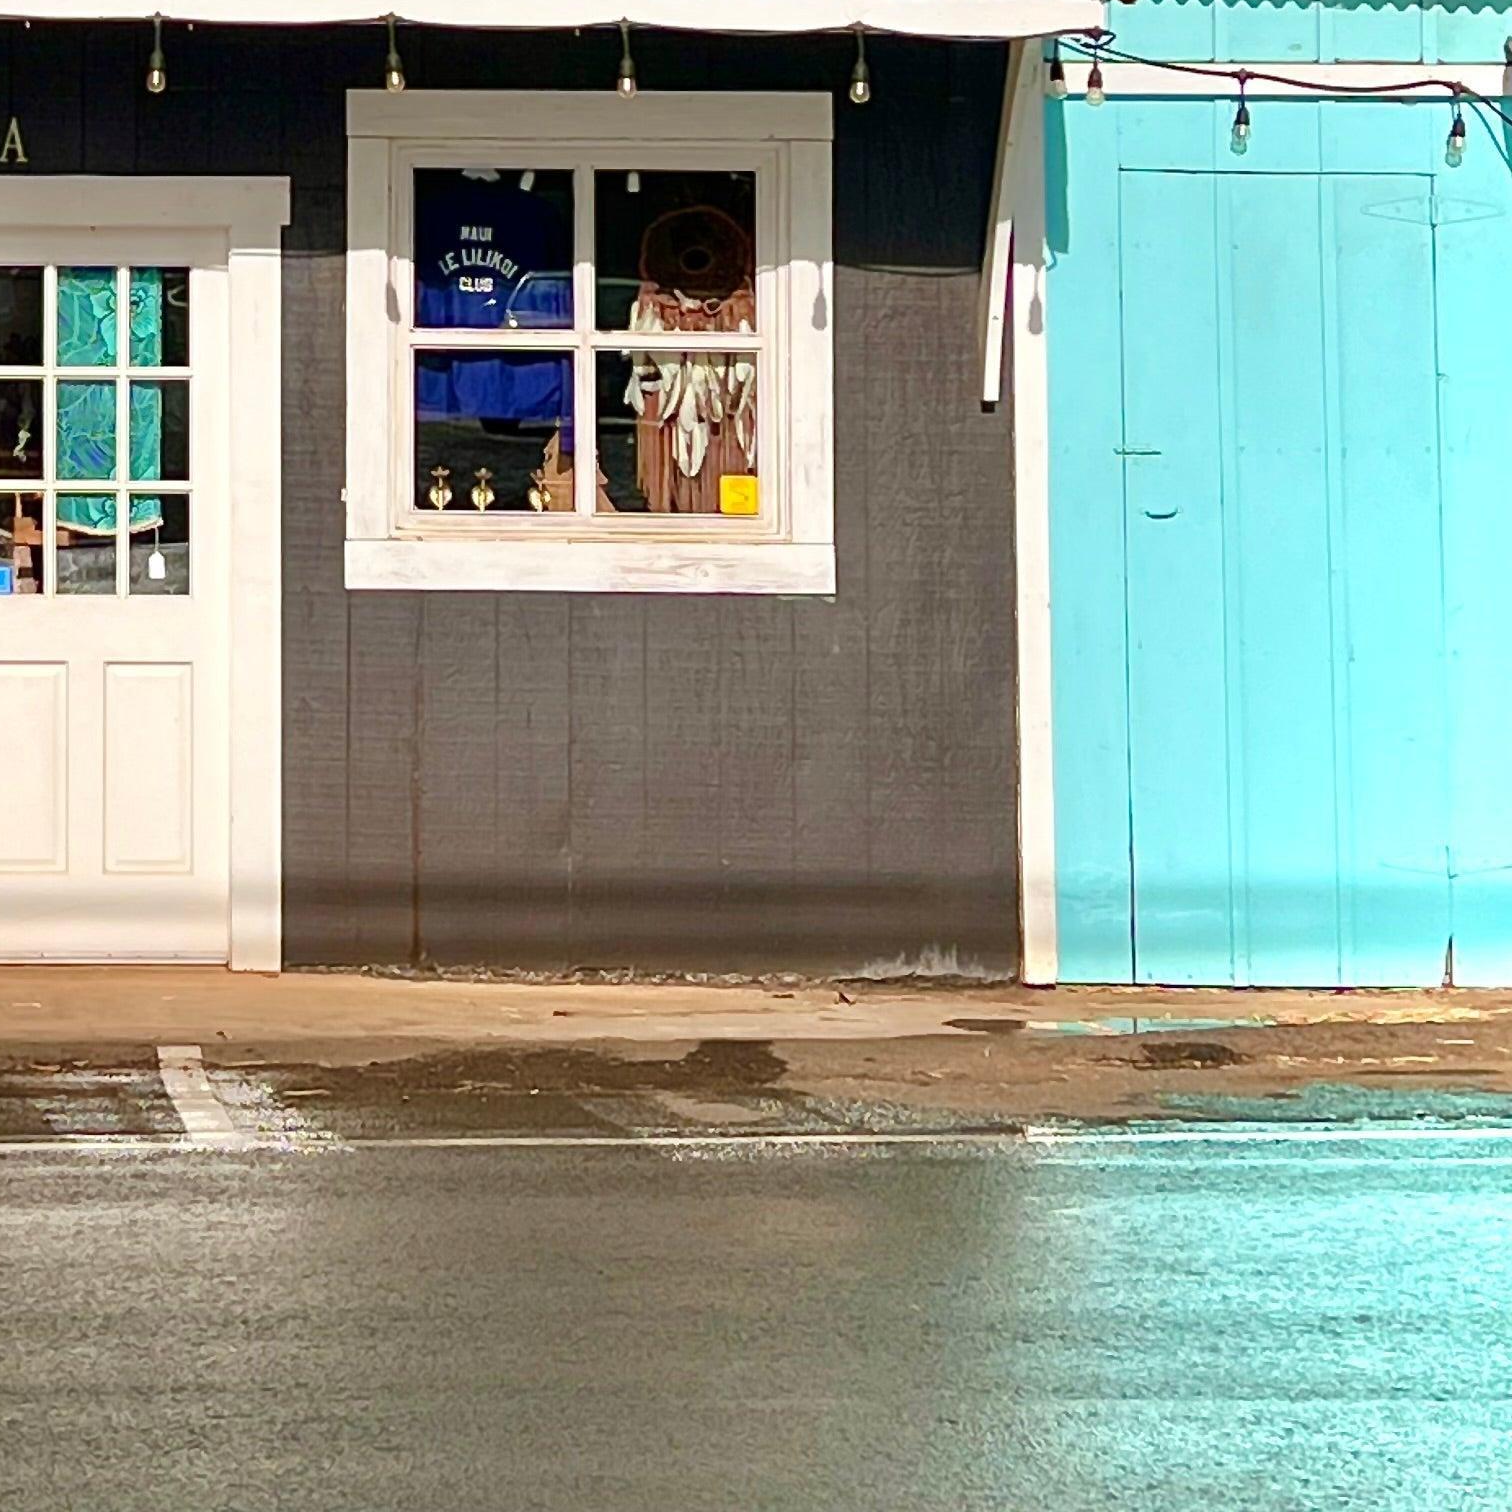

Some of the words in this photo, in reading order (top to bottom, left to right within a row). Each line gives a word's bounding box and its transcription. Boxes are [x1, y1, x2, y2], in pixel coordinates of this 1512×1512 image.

[460, 226, 492, 241] MAUI
[438, 252, 460, 276] LE
[461, 248, 519, 279] LILIKOI
[459, 276, 493, 292] CLUB
